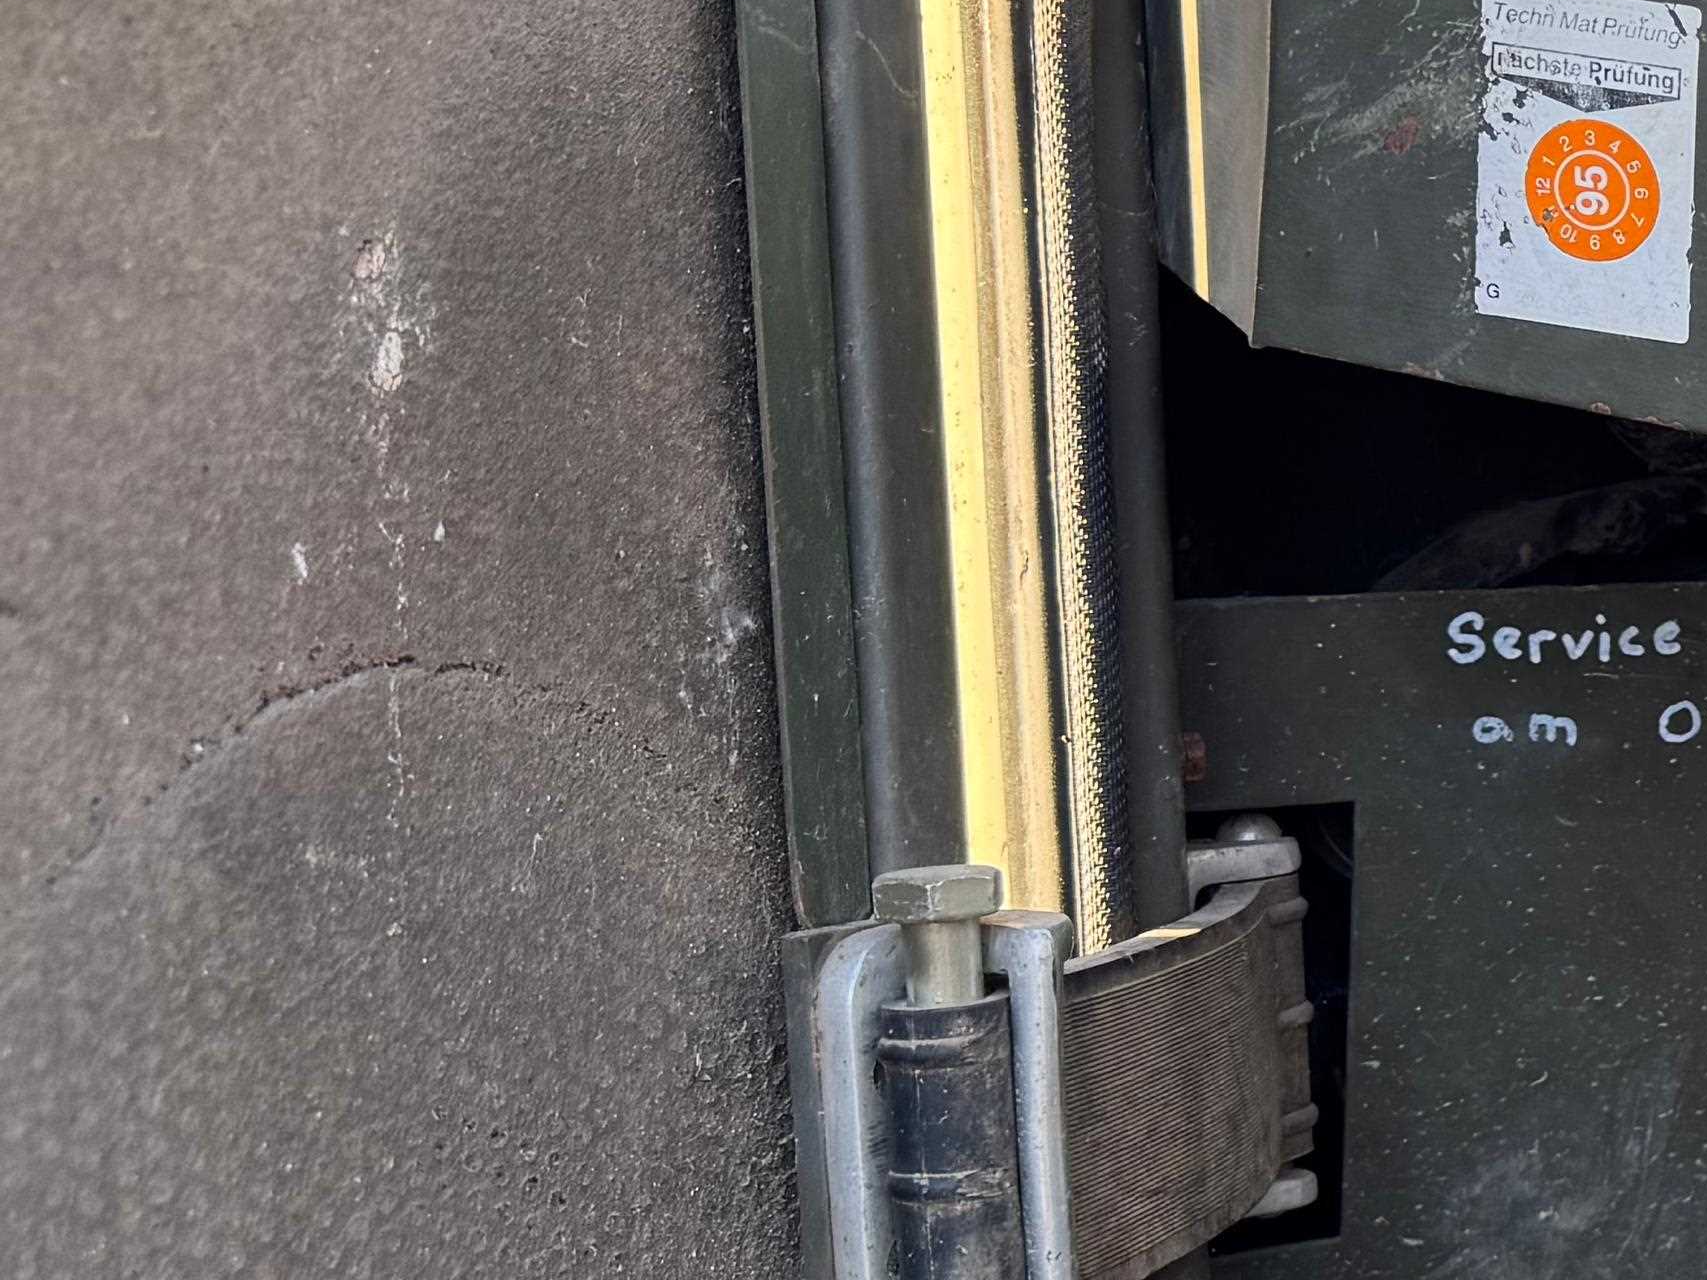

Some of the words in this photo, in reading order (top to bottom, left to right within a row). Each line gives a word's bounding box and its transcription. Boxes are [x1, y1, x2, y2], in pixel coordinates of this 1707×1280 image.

[1589, 60, 1674, 94] Prüfung
[1559, 136, 1573, 152] 2
[1584, 130, 1596, 146] 3
[1608, 140, 1621, 154] 4
[1541, 155, 1556, 166] 1
[1535, 177, 1551, 197] 12
[1573, 165, 1610, 216] 95
[1634, 188, 1649, 199] 6
[1631, 213, 1645, 228] 7
[1559, 223, 1579, 243] 10
[1612, 229, 1626, 245] 8
[1589, 235, 1601, 251] 9
[1446, 609, 1683, 665] Service
[1471, 712, 1578, 747] am
